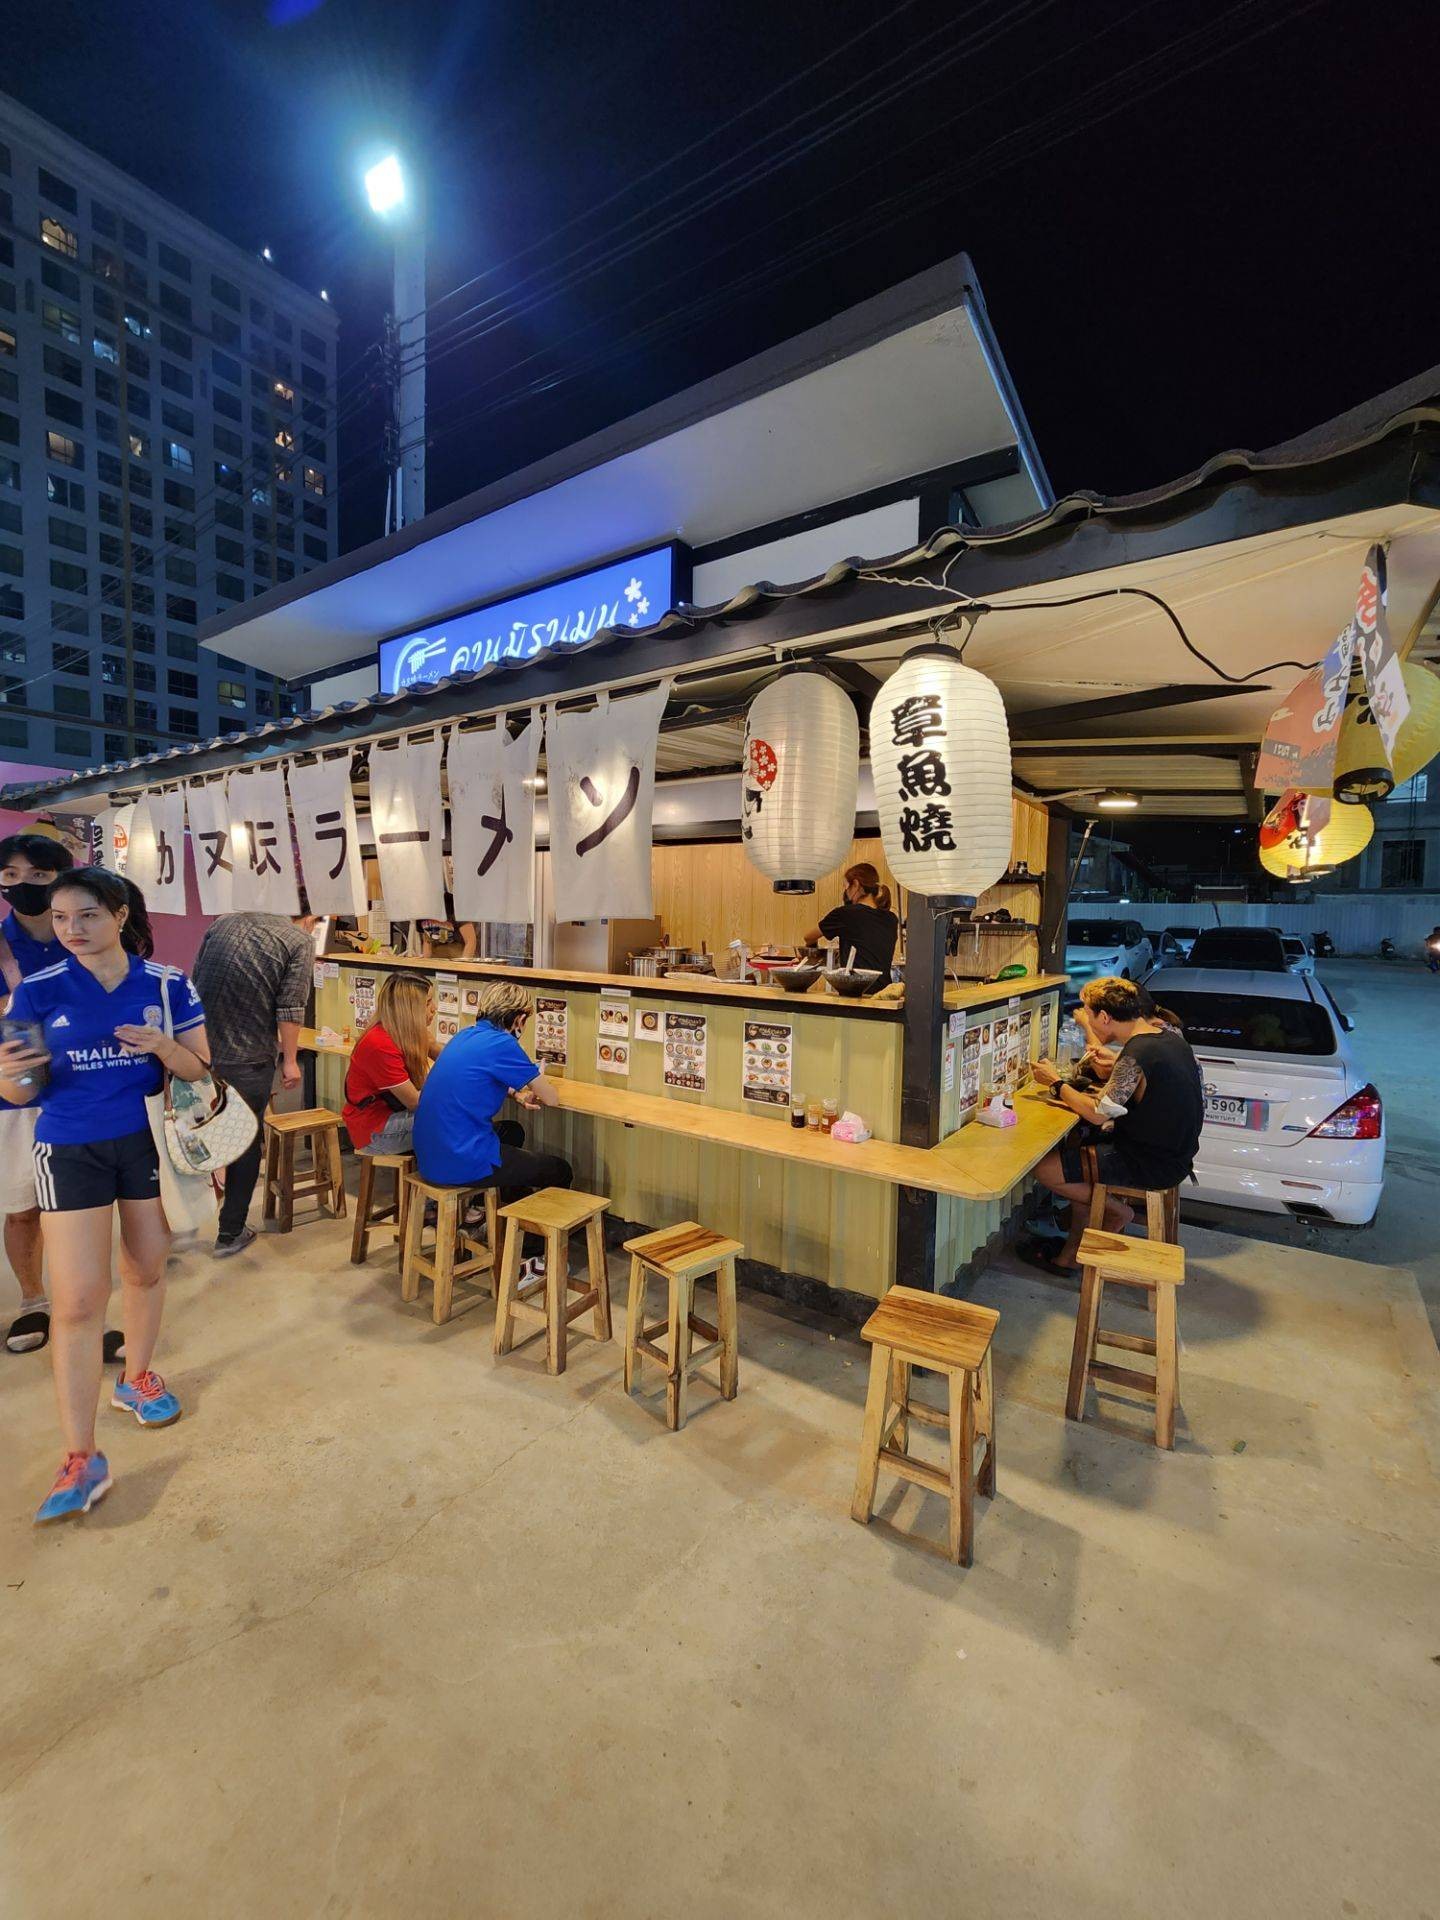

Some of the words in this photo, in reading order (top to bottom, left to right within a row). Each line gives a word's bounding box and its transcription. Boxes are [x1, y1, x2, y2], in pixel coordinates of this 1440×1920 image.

[66, 1045, 148, 1062] THAILA
[105, 1058, 131, 1067] WITH
[1211, 1098, 1245, 1114] 5904
